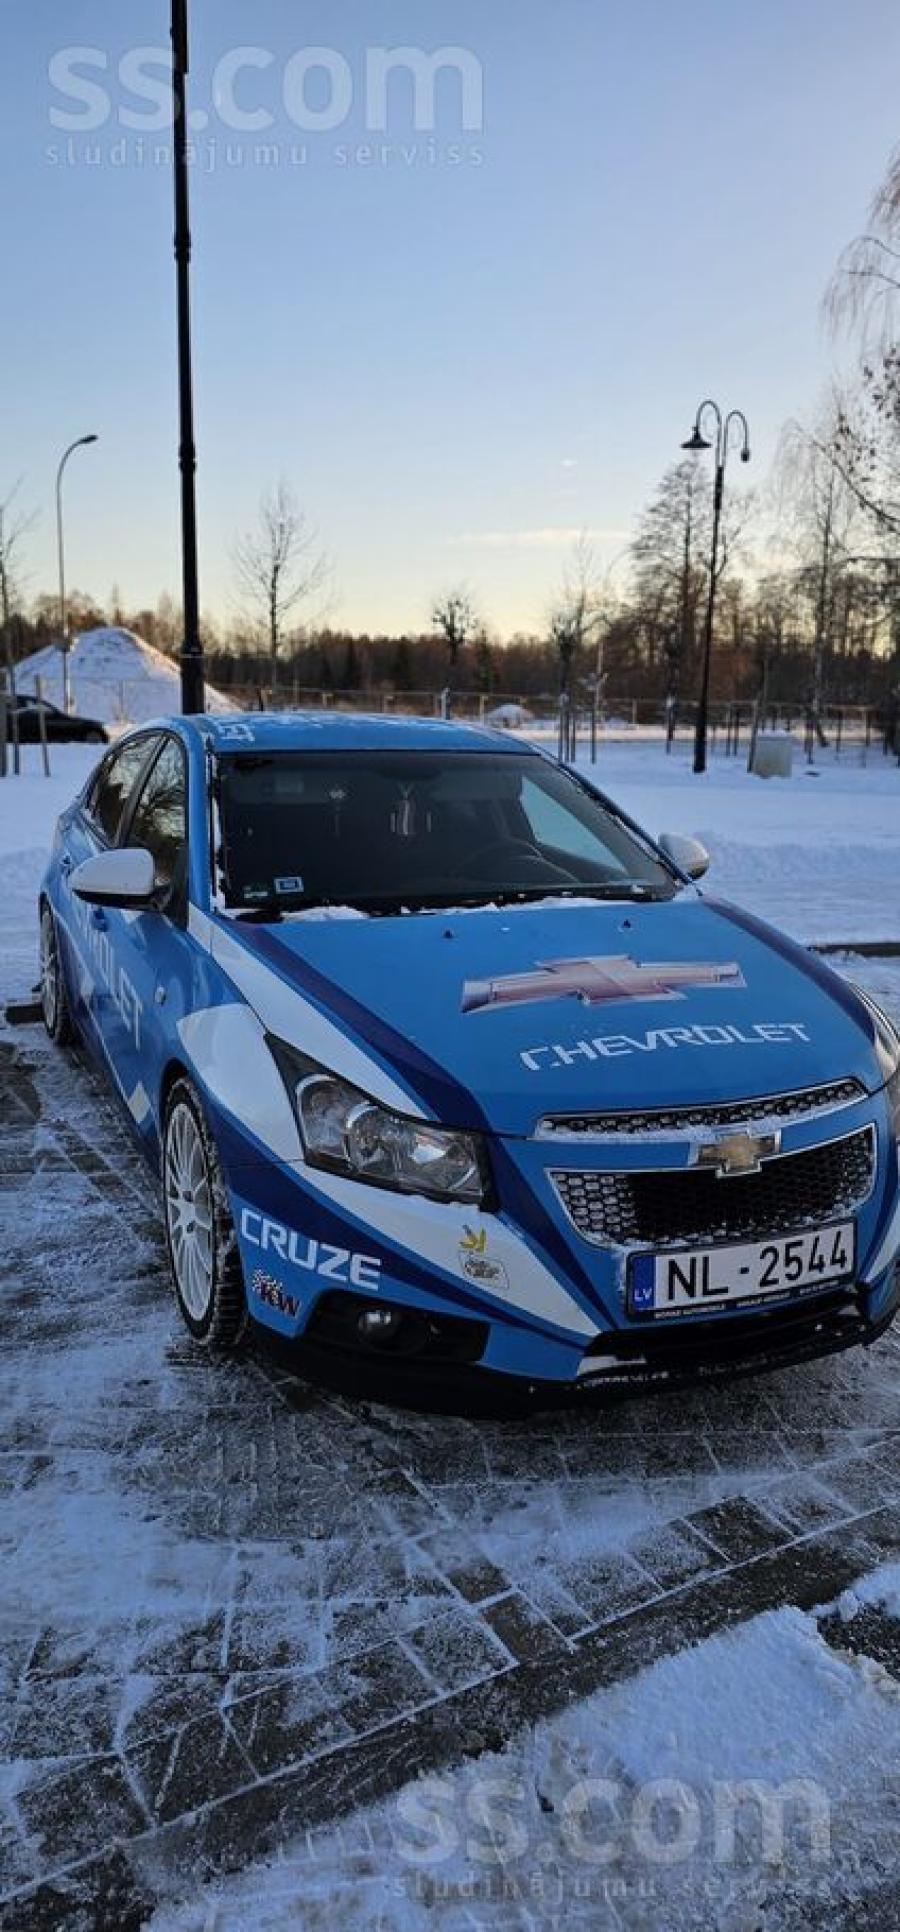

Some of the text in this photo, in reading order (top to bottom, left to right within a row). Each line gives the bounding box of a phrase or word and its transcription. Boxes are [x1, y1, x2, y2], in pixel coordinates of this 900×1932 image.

[519, 1021, 812, 1071] CHEVROLET
[240, 1207, 382, 1291] CRUZE
[633, 1286, 653, 1302] LV
